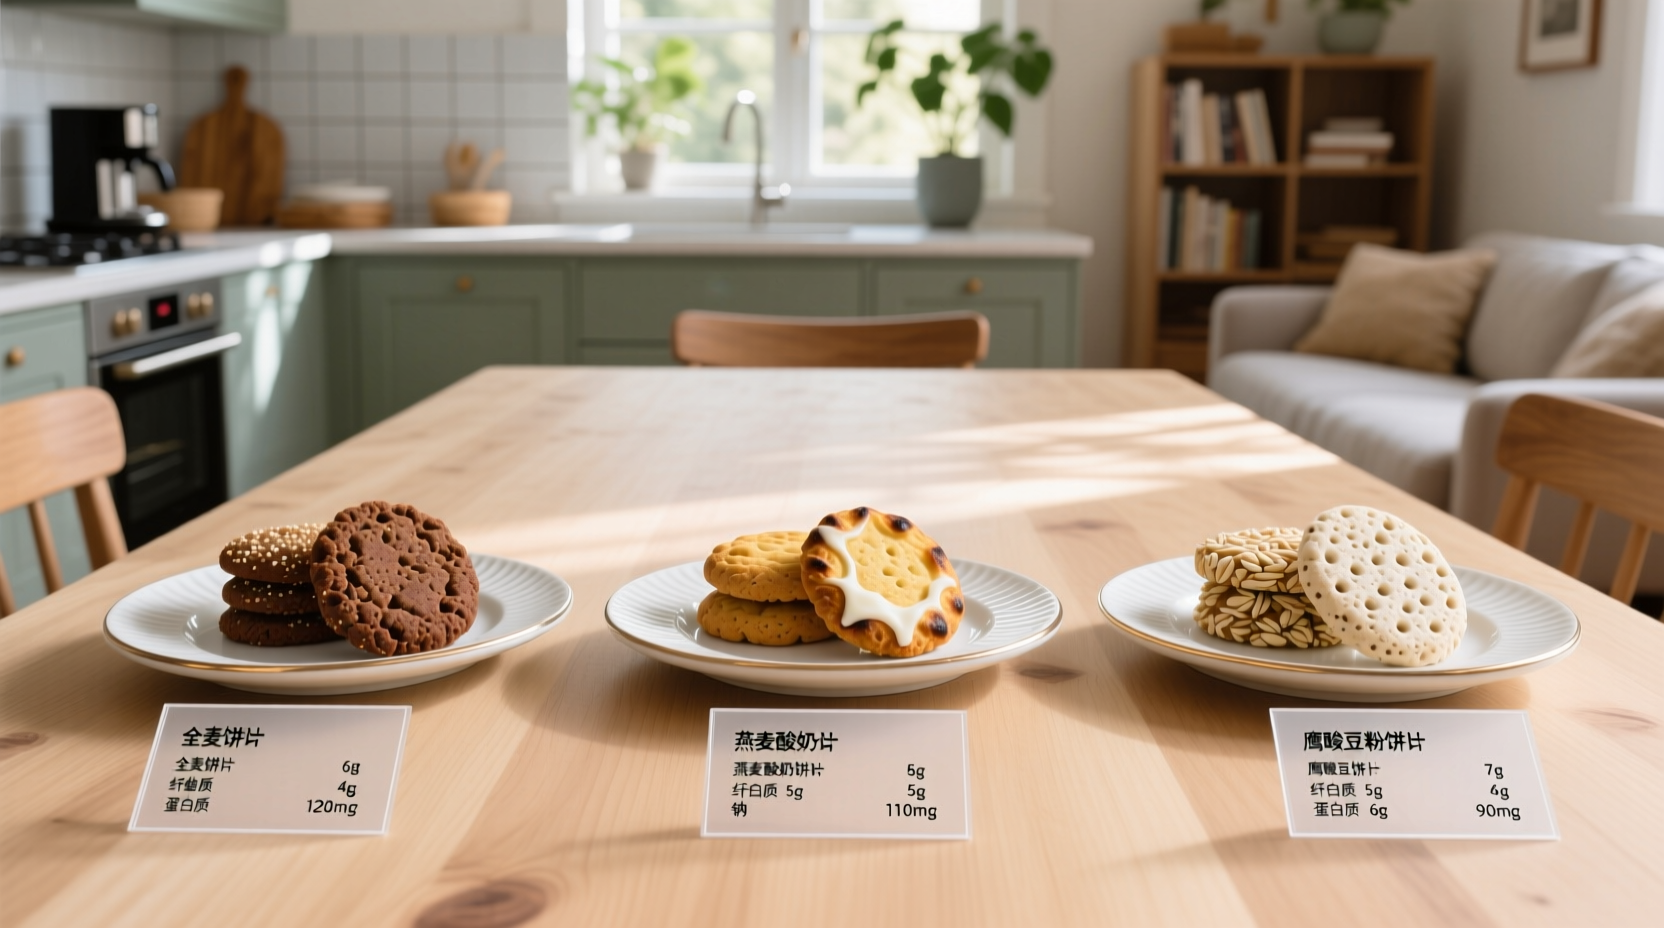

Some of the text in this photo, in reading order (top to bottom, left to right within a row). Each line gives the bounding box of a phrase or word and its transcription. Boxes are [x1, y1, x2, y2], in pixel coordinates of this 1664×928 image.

[182, 725, 265, 748] 全麦饼片
[175, 757, 360, 775] 全麦饼片 6g
[1484, 764, 1504, 779] 7g
[338, 781, 356, 797] 4g
[786, 785, 803, 800] 5g
[908, 784, 925, 800] 5g
[1365, 784, 1383, 799] 5g
[307, 799, 358, 817] 120mg
[886, 803, 937, 820] 110mg
[1370, 804, 1388, 819] 6g
[1476, 804, 1521, 821] 90mg
